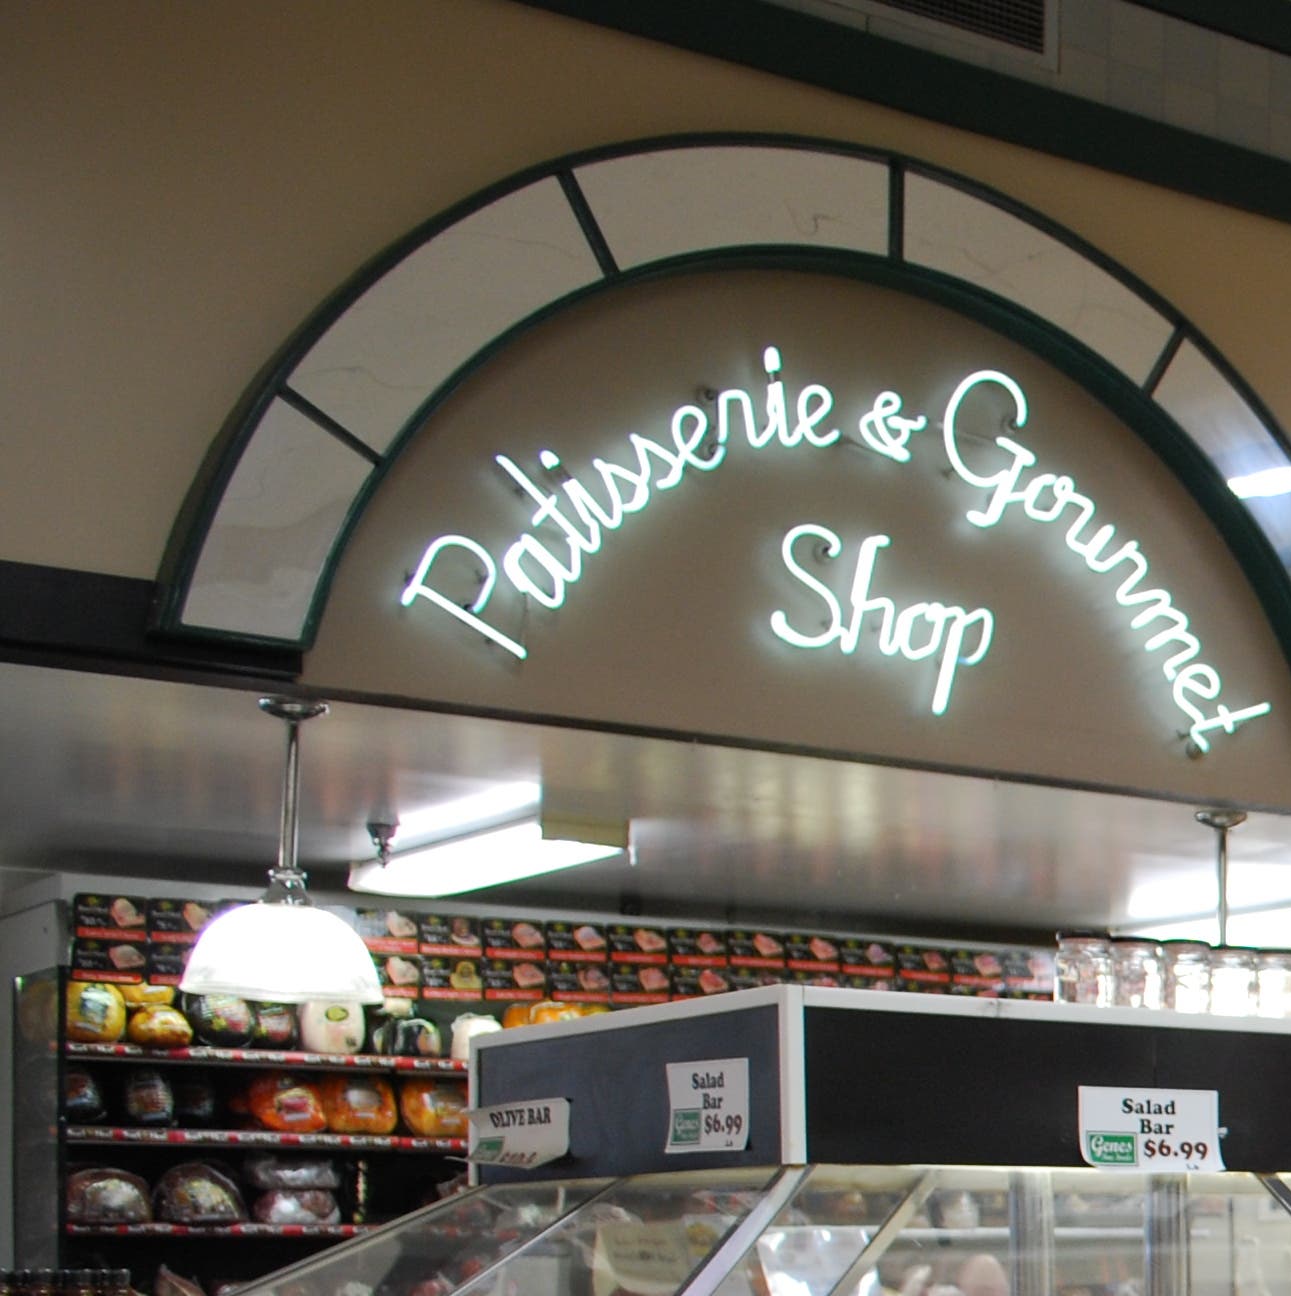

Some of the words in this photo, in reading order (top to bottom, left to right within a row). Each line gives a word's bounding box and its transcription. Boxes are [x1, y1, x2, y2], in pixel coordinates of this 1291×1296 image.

[402, 346, 840, 658] Patisserie
[859, 390, 926, 461] &
[943, 369, 1271, 754] Gourmet
[770, 523, 995, 716] Shop
[691, 1072, 725, 1090] Salad
[701, 1094, 724, 1111] Bar
[1121, 1098, 1177, 1116] Salad
[527, 1106, 552, 1125] BAR
[704, 1114, 743, 1136] $6.99
[1139, 1118, 1175, 1135] Bar
[1143, 1139, 1209, 1161] $6.99
